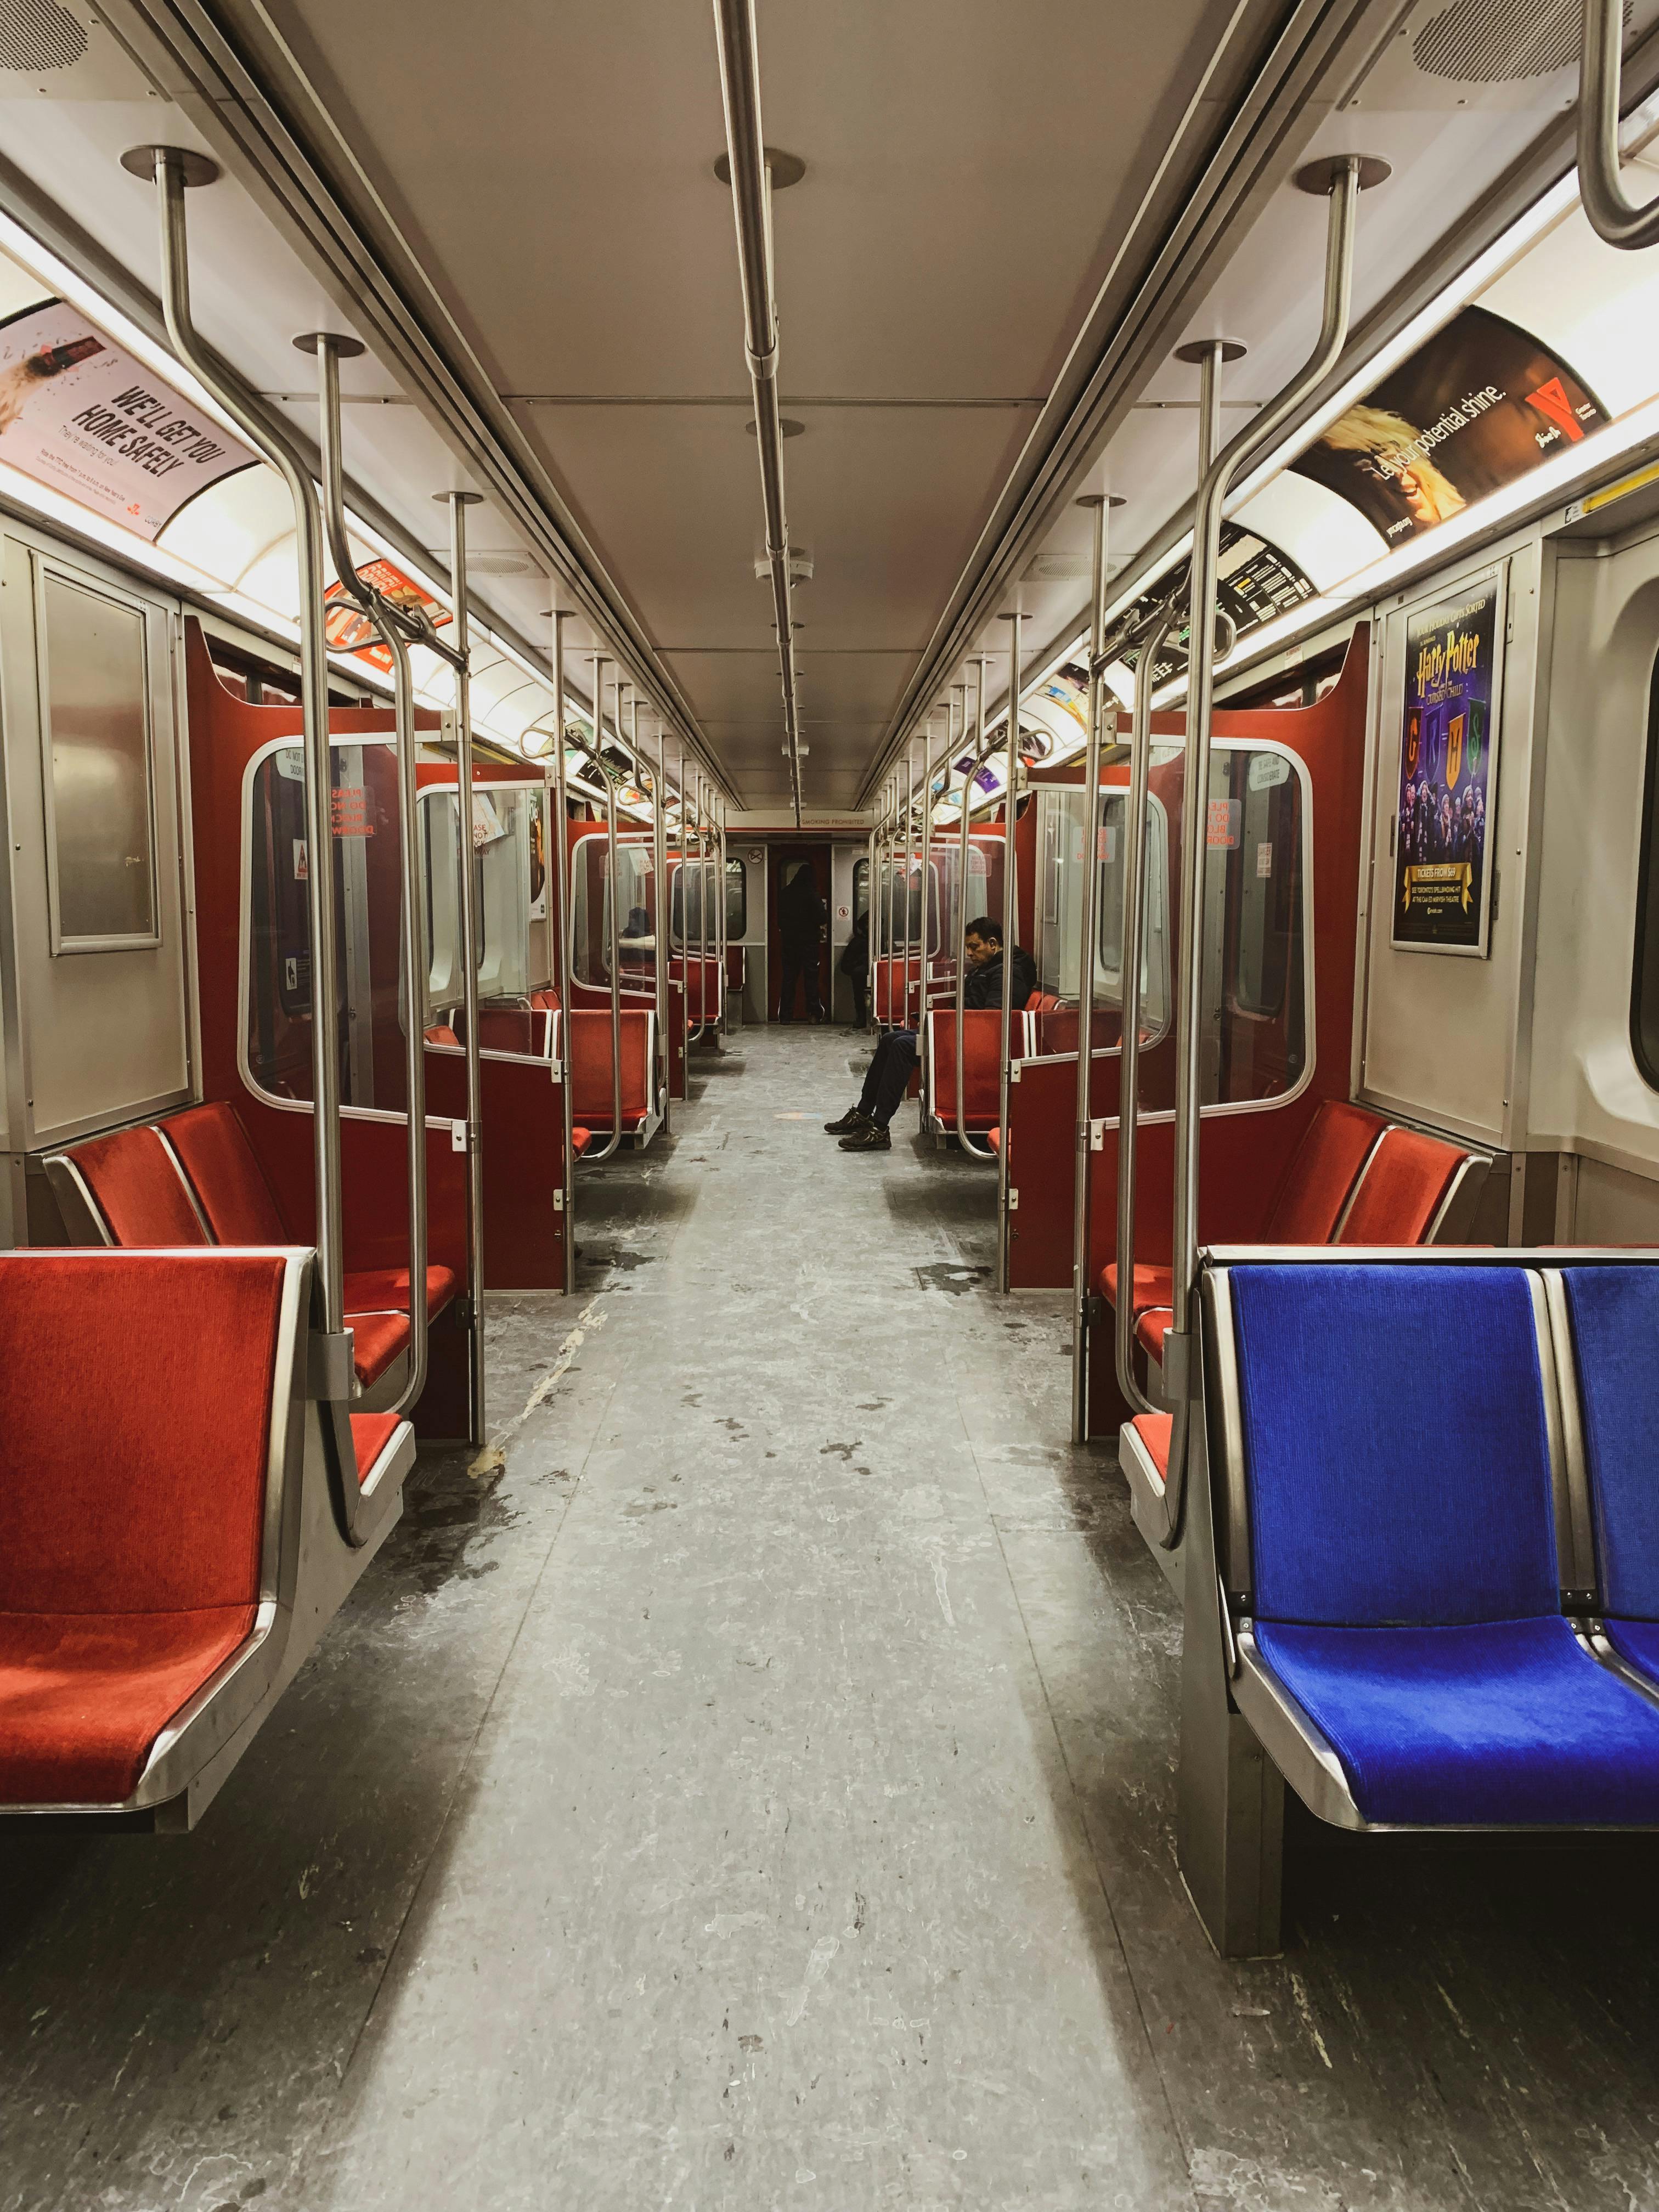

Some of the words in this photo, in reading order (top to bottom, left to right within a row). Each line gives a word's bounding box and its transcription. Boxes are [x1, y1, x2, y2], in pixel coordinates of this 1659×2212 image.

[58, 425, 80, 444] They're
[78, 439, 99, 456] waiting
[98, 450, 107, 459] for
[71, 404, 138, 446] HOME
[119, 436, 184, 477] SAFELY
[111, 386, 173, 429] WE'LL
[155, 420, 202, 445] GET
[182, 437, 225, 463] YOU
[1371, 461, 1400, 481] Let
[1393, 445, 1420, 473] your
[1414, 407, 1470, 456] potential
[1462, 386, 1506, 418] shine.
[1465, 599, 1485, 617] SORTED
[1417, 644, 1446, 698] Harry
[1446, 630, 1480, 689] Potter
[1427, 690, 1444, 705] CURSED
[1447, 684, 1464, 698] CHILD
[1418, 868, 1434, 878] TICKETS
[1434, 868, 1448, 877] FROM
[1448, 867, 1456, 877] $69
